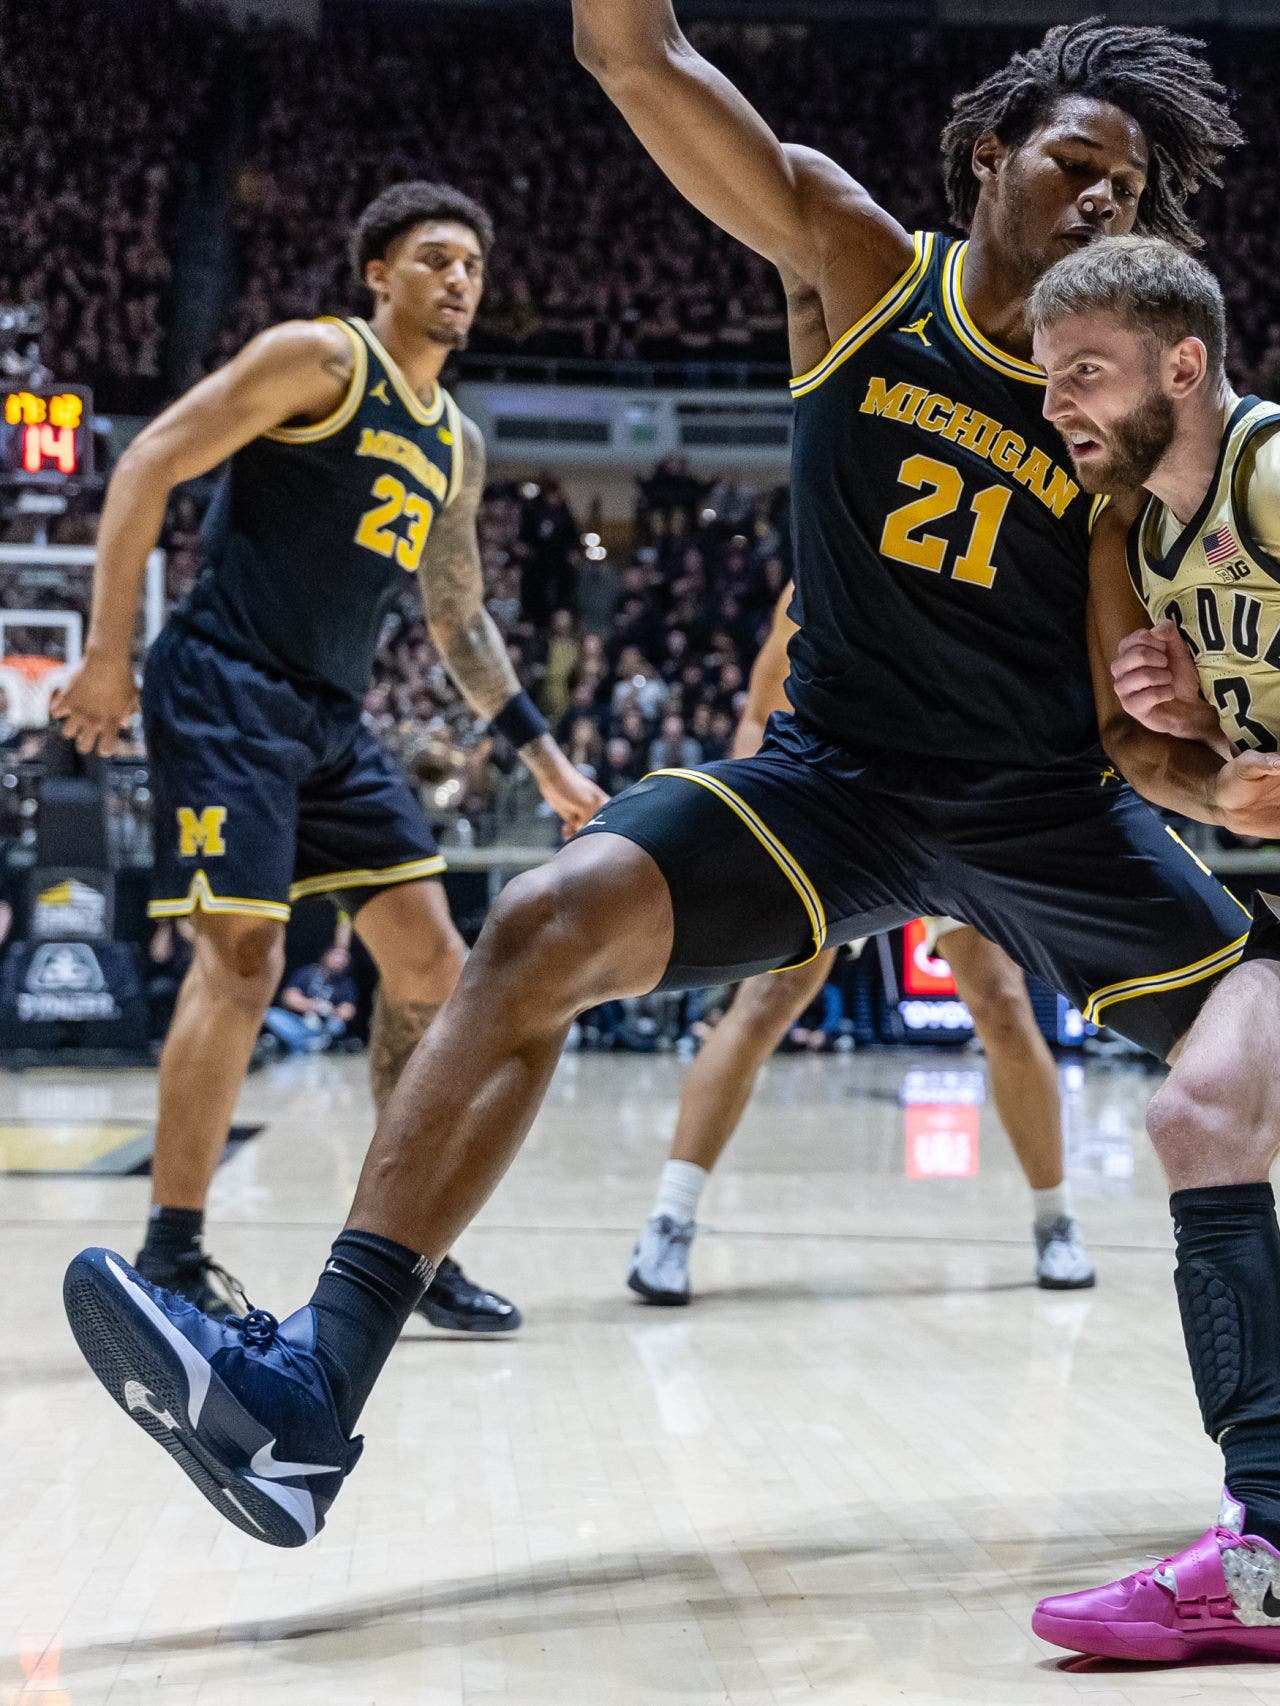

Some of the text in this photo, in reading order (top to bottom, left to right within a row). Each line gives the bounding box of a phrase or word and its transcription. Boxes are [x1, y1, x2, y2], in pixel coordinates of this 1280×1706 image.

[23, 424, 77, 474] 14
[859, 376, 1080, 520] MICHIGAN
[354, 474, 433, 573] 23
[879, 454, 1013, 589] 21
[1212, 676, 1280, 754] 3
[176, 806, 227, 857] M
